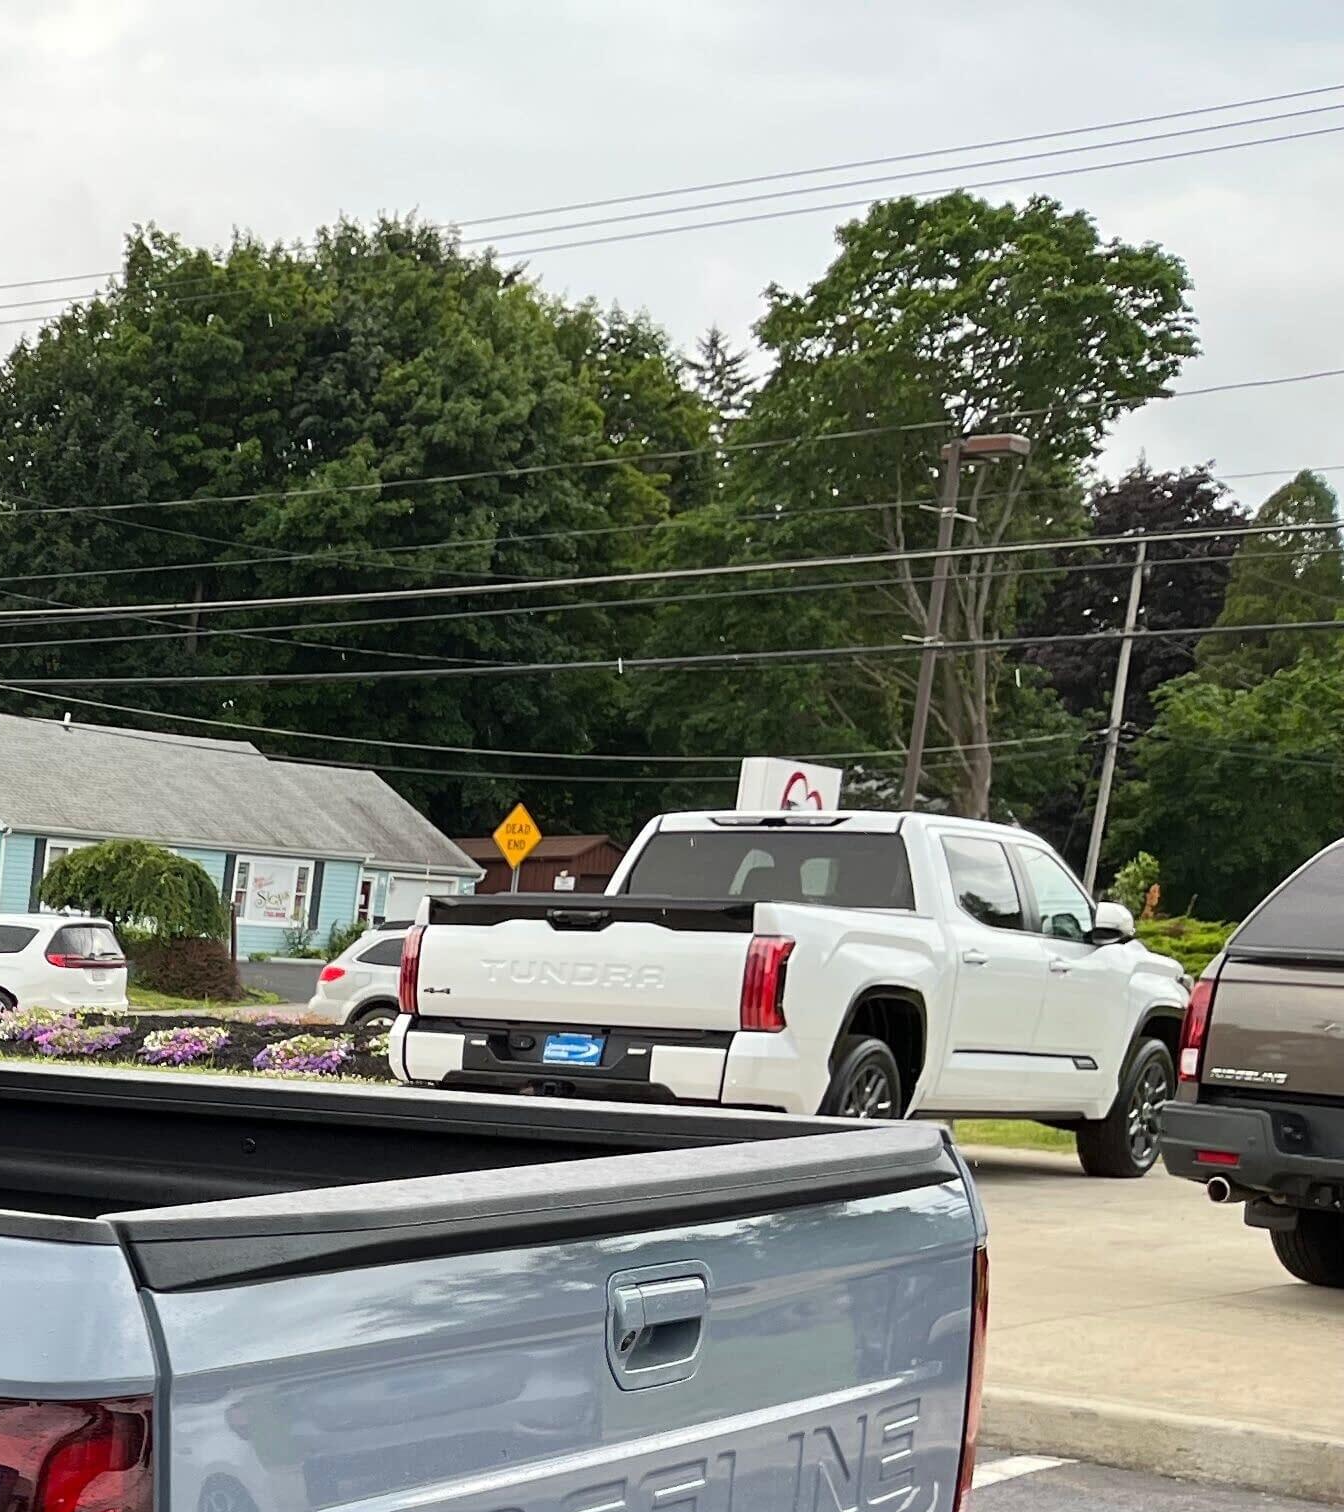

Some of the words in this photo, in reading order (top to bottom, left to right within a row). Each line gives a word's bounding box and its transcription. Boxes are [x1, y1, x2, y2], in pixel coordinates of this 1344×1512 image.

[505, 823, 531, 835] DEAD
[507, 839, 526, 850] END
[480, 959, 665, 990] TUNDRA
